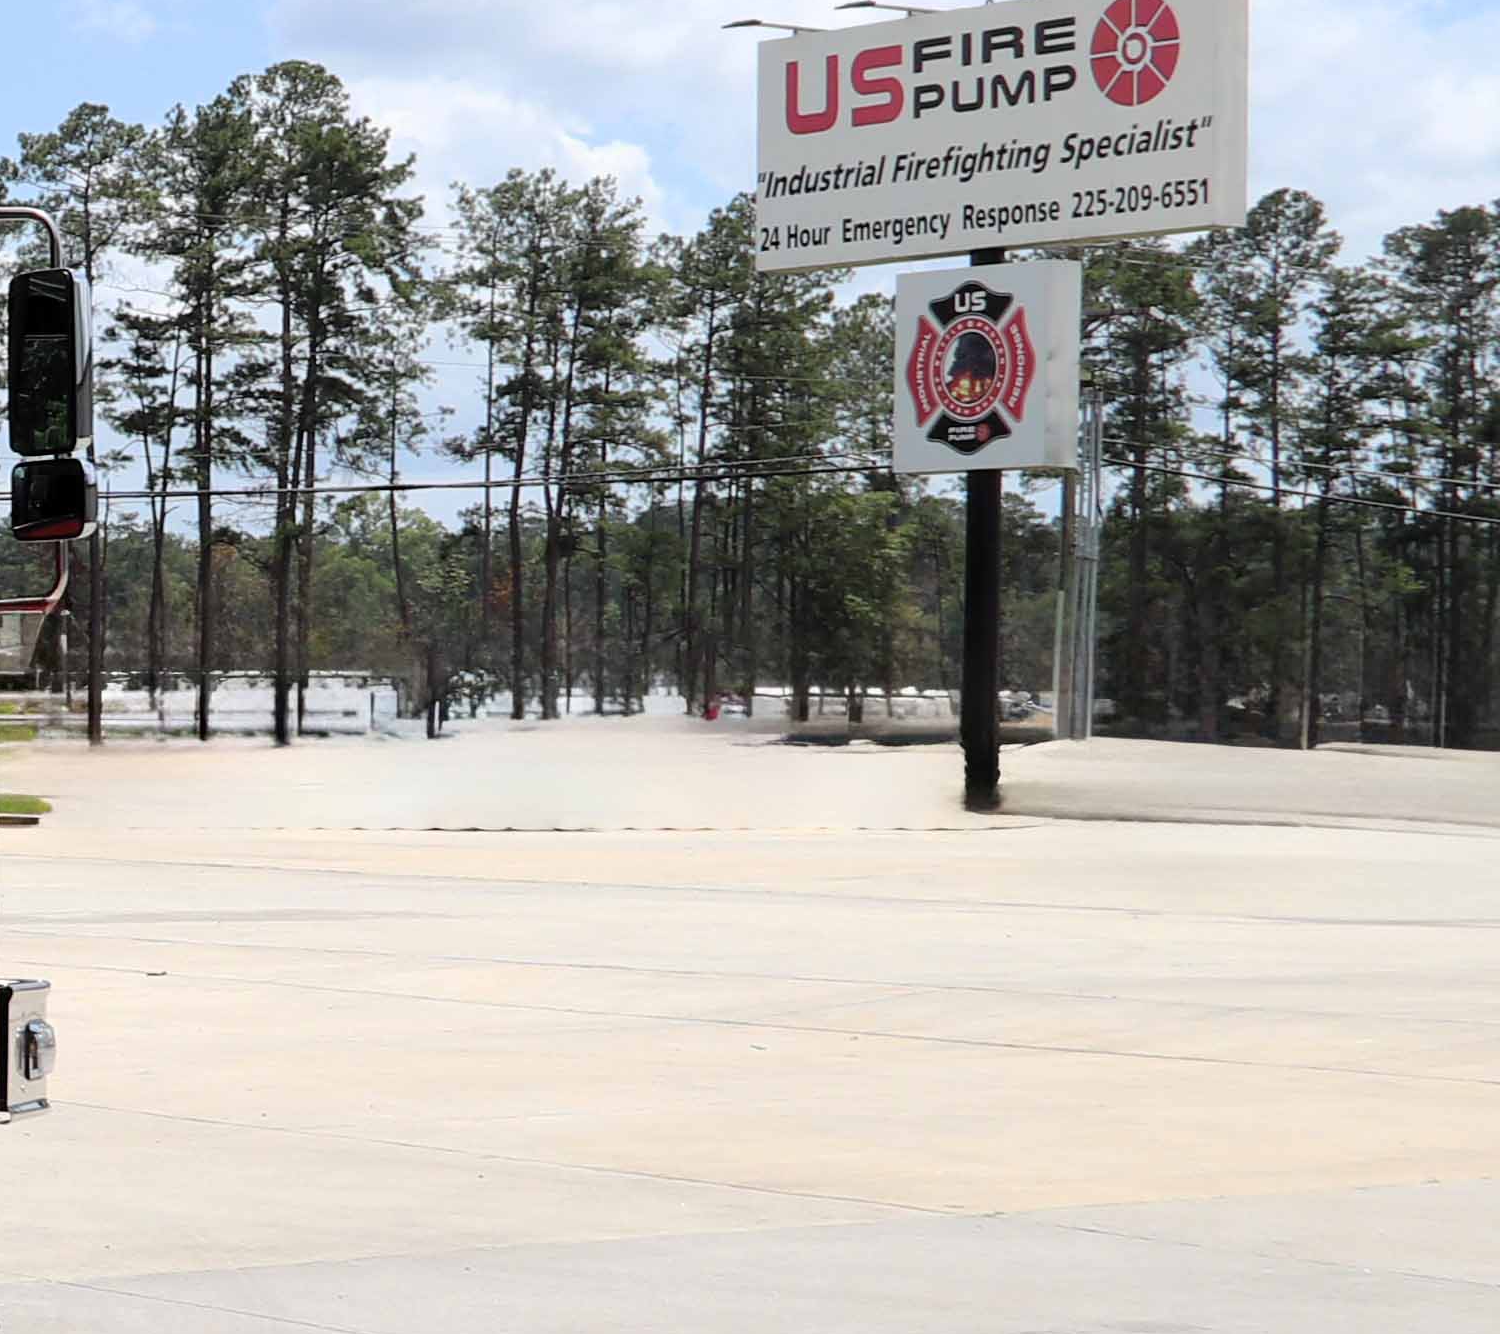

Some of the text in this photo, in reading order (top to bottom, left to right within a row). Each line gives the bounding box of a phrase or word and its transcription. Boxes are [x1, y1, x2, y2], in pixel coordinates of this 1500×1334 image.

[913, 17, 1076, 74] FIRE
[786, 44, 904, 135] US
[913, 64, 1077, 119] PUMP
[891, 138, 1051, 184] Firefighting
[760, 177, 1211, 252] 24 Hour Emergency Response 225-209-6551
[954, 290, 987, 313] US
